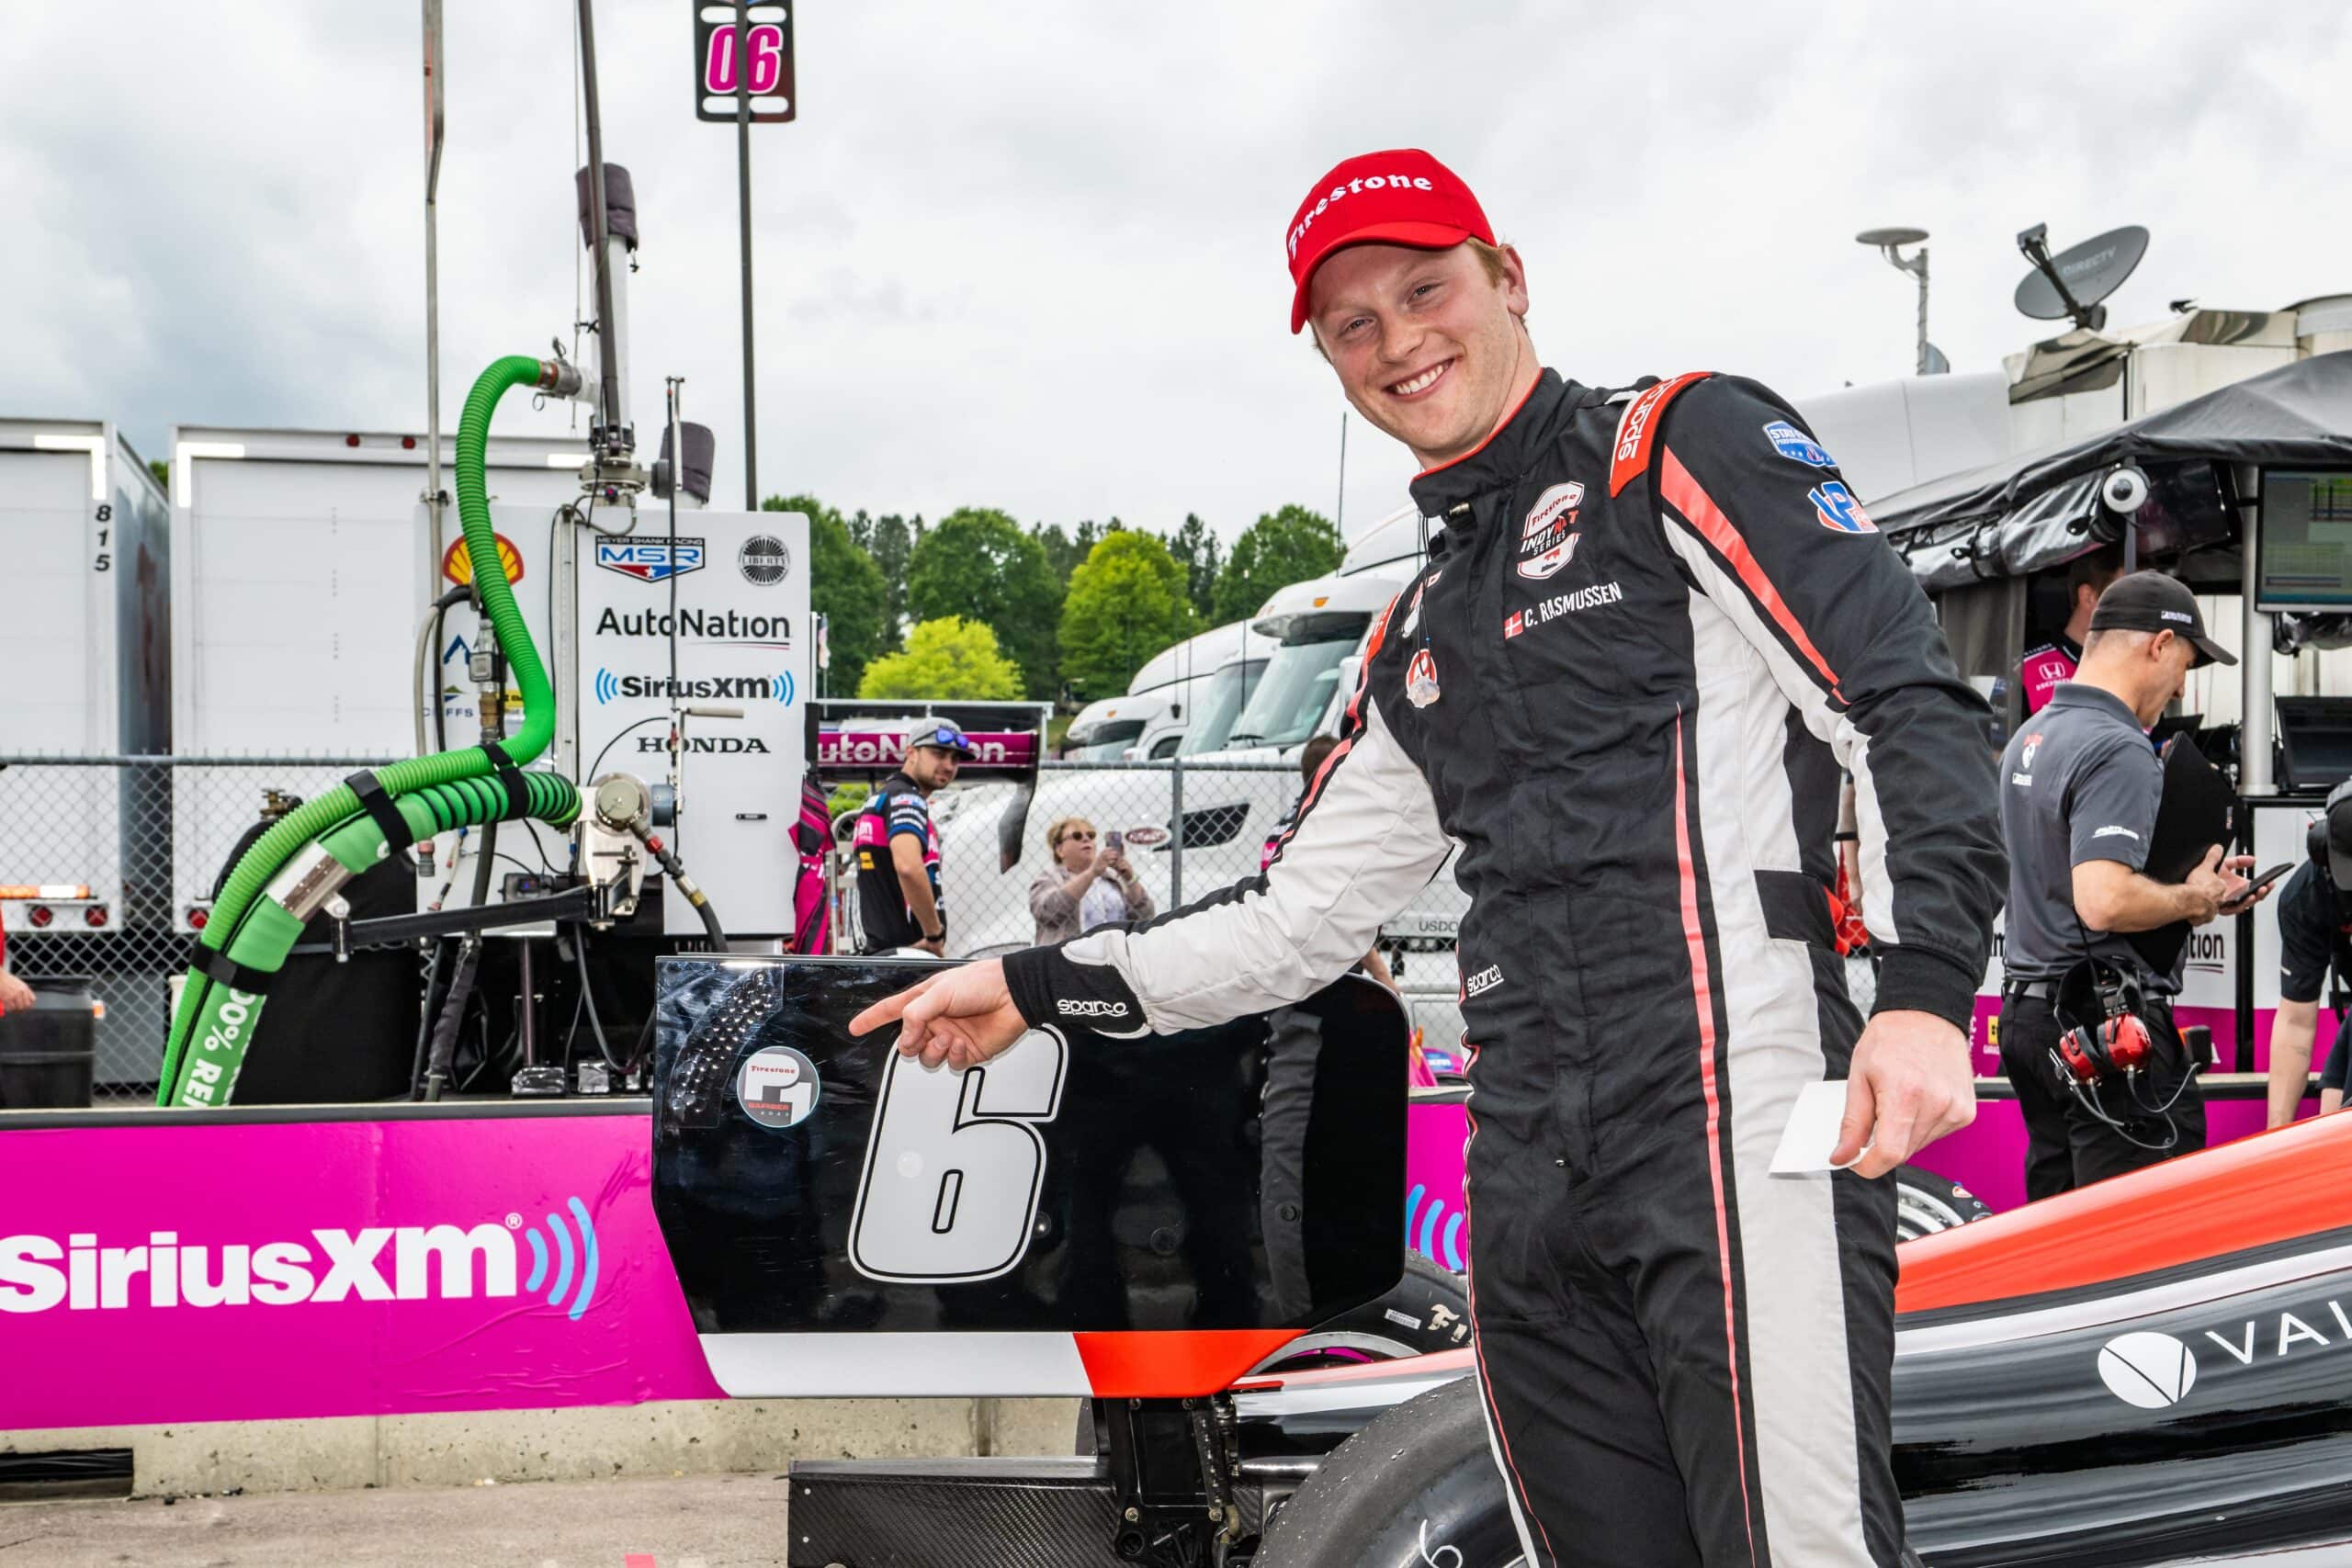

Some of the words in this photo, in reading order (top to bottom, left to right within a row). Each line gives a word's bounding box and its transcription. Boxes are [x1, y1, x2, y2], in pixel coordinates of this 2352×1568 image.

[705, 24, 783, 94] 06
[1288, 174, 1433, 260] Firestone
[1532, 494, 1577, 527] Firestone
[602, 547, 699, 563] MSR
[1533, 530, 1566, 556] SERIES
[1525, 608, 1539, 627] C.
[1539, 581, 1623, 623] RASMUSSEN
[596, 607, 791, 637] AutoNation
[1467, 964, 1503, 997] sparco
[1057, 998, 1129, 1017] sparco
[750, 1066, 796, 1075] Firestone
[848, 1022, 1069, 1284] 6
